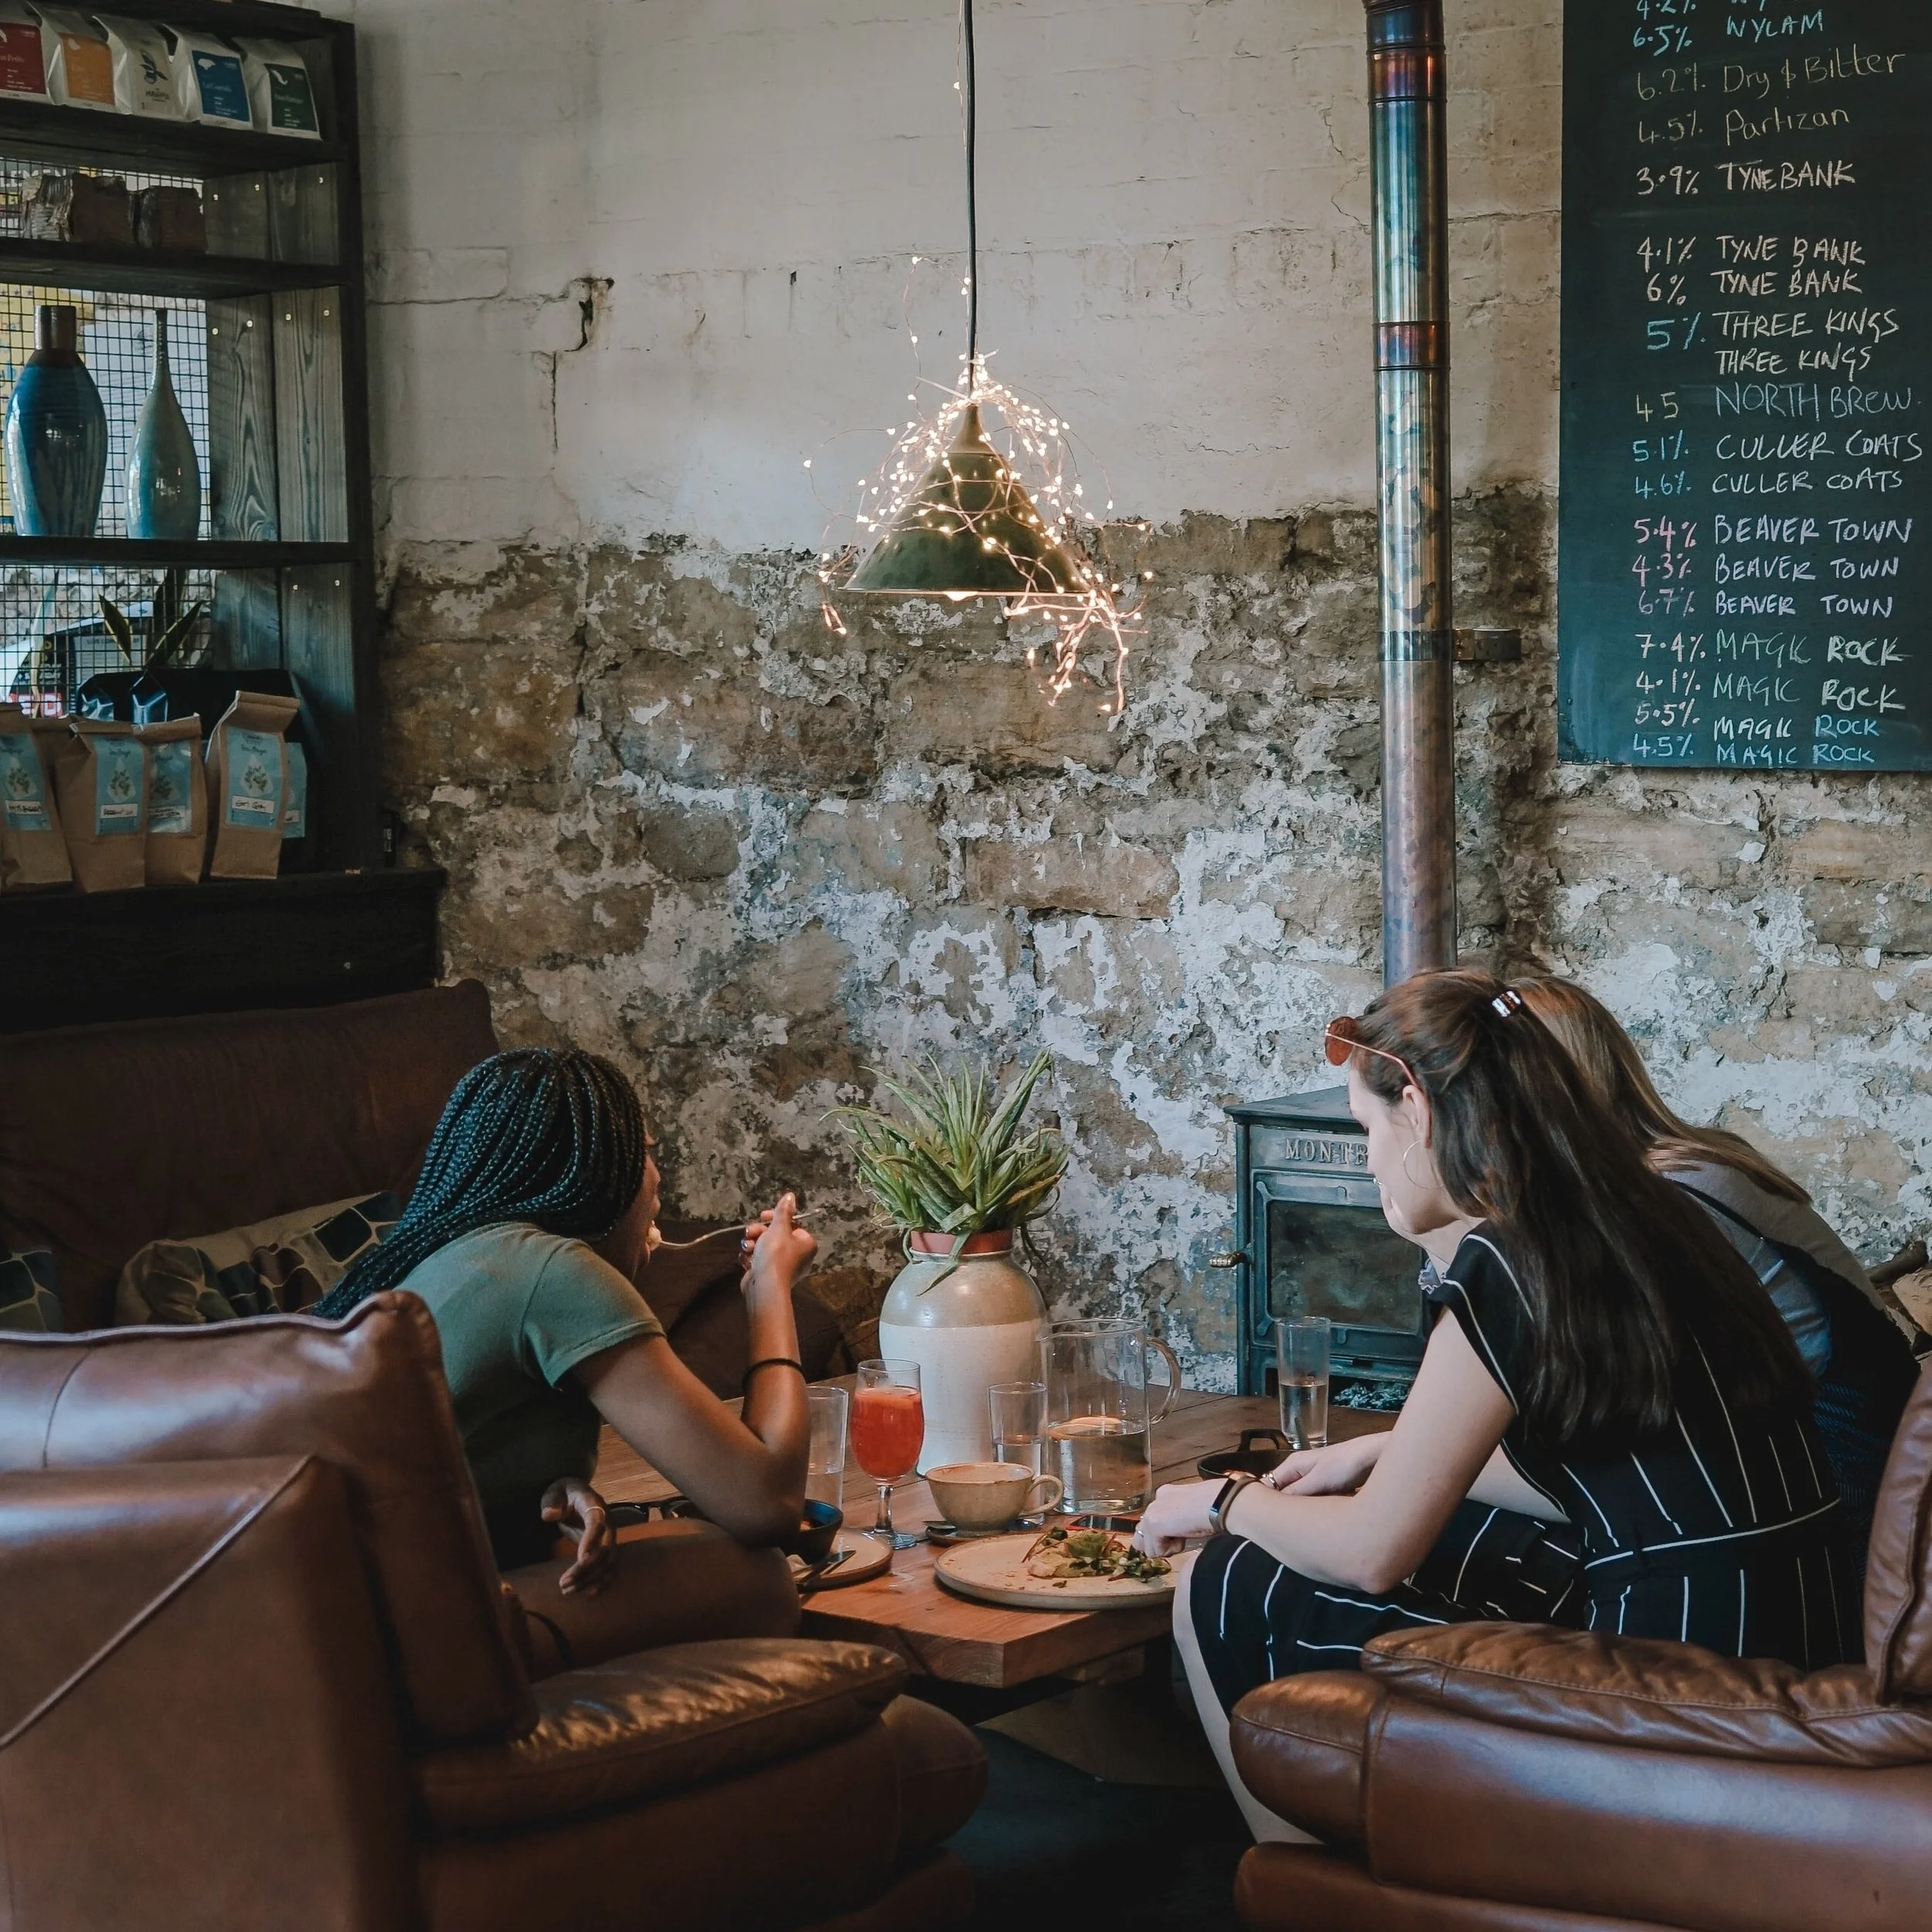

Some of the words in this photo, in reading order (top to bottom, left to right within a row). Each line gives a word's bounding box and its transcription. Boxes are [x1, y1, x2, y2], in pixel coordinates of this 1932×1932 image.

[1632, 24, 1692, 56] 6.5%
[1726, 9, 1823, 43] WYLAM
[1637, 63, 1706, 100] 6.2%
[1723, 65, 1770, 99] Dry
[1805, 43, 1906, 82] Bitter
[1638, 111, 1703, 145] 4.5%
[1726, 107, 1849, 146] Partizan
[1636, 166, 1699, 196] 3.9%
[1637, 236, 1696, 274] 4.1%
[1716, 235, 1780, 261] TYNE
[1793, 237, 1866, 267] BANK
[1646, 272, 1688, 305] 6%
[1710, 270, 1777, 297] TYNE
[1788, 269, 1862, 298] BANK
[1646, 311, 1706, 351] 5%
[1712, 311, 1813, 341] THREE
[1825, 308, 1900, 343] KINGS
[1715, 349, 1787, 375] THREE
[1798, 342, 1873, 382] KINGS
[1716, 381, 1820, 422] NORTH
[1632, 430, 1689, 463] 5.1%
[1716, 432, 1834, 461] CULLER
[1845, 430, 1923, 462] COATS
[1635, 471, 1691, 500] 4.6%
[1713, 468, 1812, 495] CULLER
[1826, 467, 1903, 493] COATS
[1633, 515, 1696, 552] 5.4%
[1715, 514, 1819, 546] BEAVER
[1828, 517, 1913, 544] TOWN
[1715, 554, 1815, 583] BEAVER
[1831, 556, 1899, 579] TOWN
[1716, 593, 1797, 614] BEAVER
[1821, 595, 1892, 618] TOWN
[1634, 632, 1706, 663] 7.4%
[1827, 634, 1913, 667] ROCK
[1635, 668, 1701, 696] 4.1%
[1821, 679, 1906, 714] ROCK
[1634, 698, 1700, 727] 5.5%
[1815, 714, 1880, 739] ROCK
[1632, 733, 1694, 758] 4.5%
[1716, 743, 1798, 767] MAGIC
[1813, 743, 1874, 764] ROCK
[1286, 1138, 1369, 1165] MONTR
